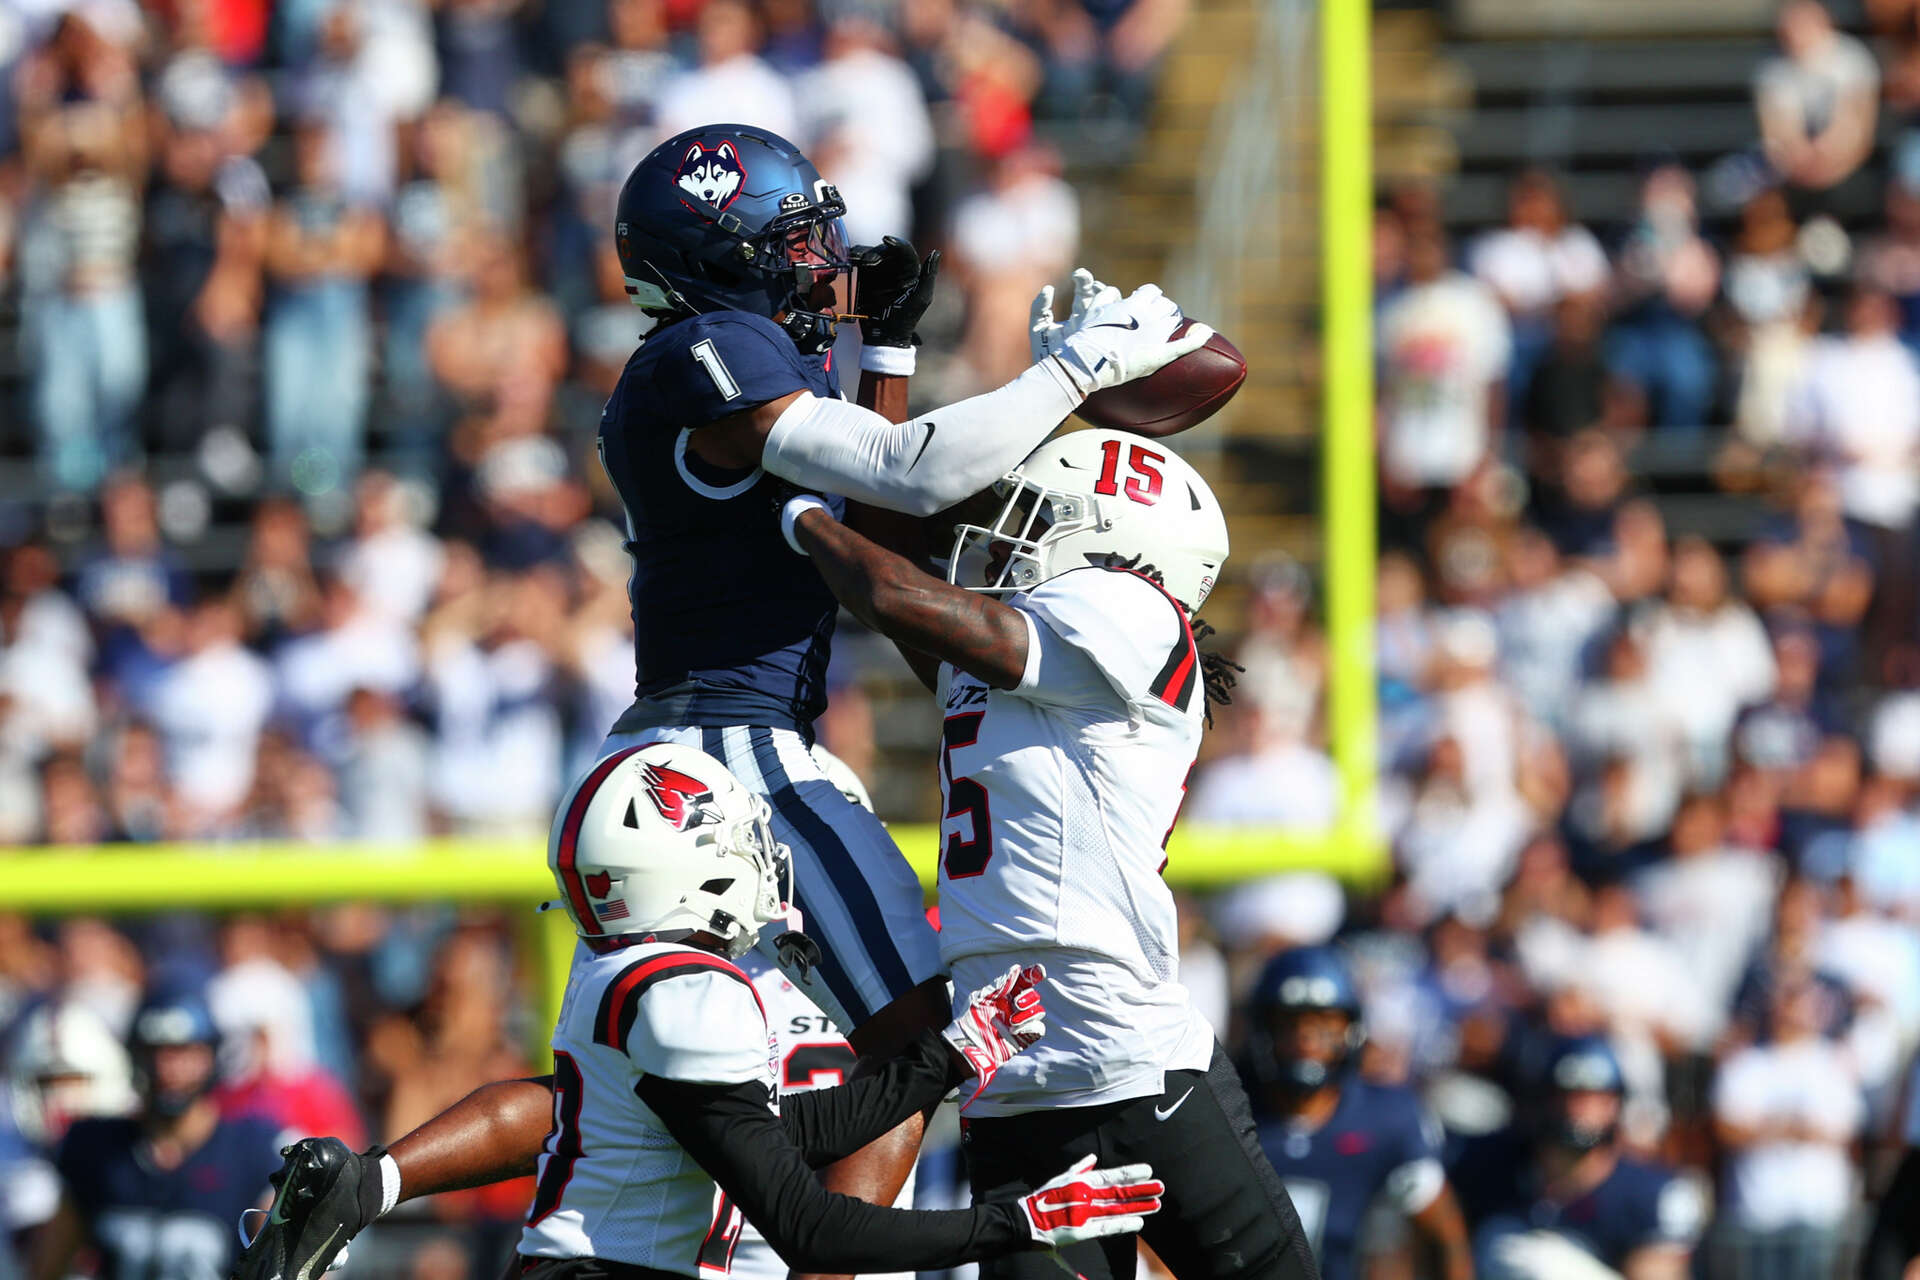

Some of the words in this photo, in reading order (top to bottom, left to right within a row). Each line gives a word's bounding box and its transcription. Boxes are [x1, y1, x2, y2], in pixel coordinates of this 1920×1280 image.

[690, 338, 741, 401] 1
[1094, 440, 1166, 506] 15
[937, 711, 993, 880] 5
[789, 1016, 841, 1034] ST
